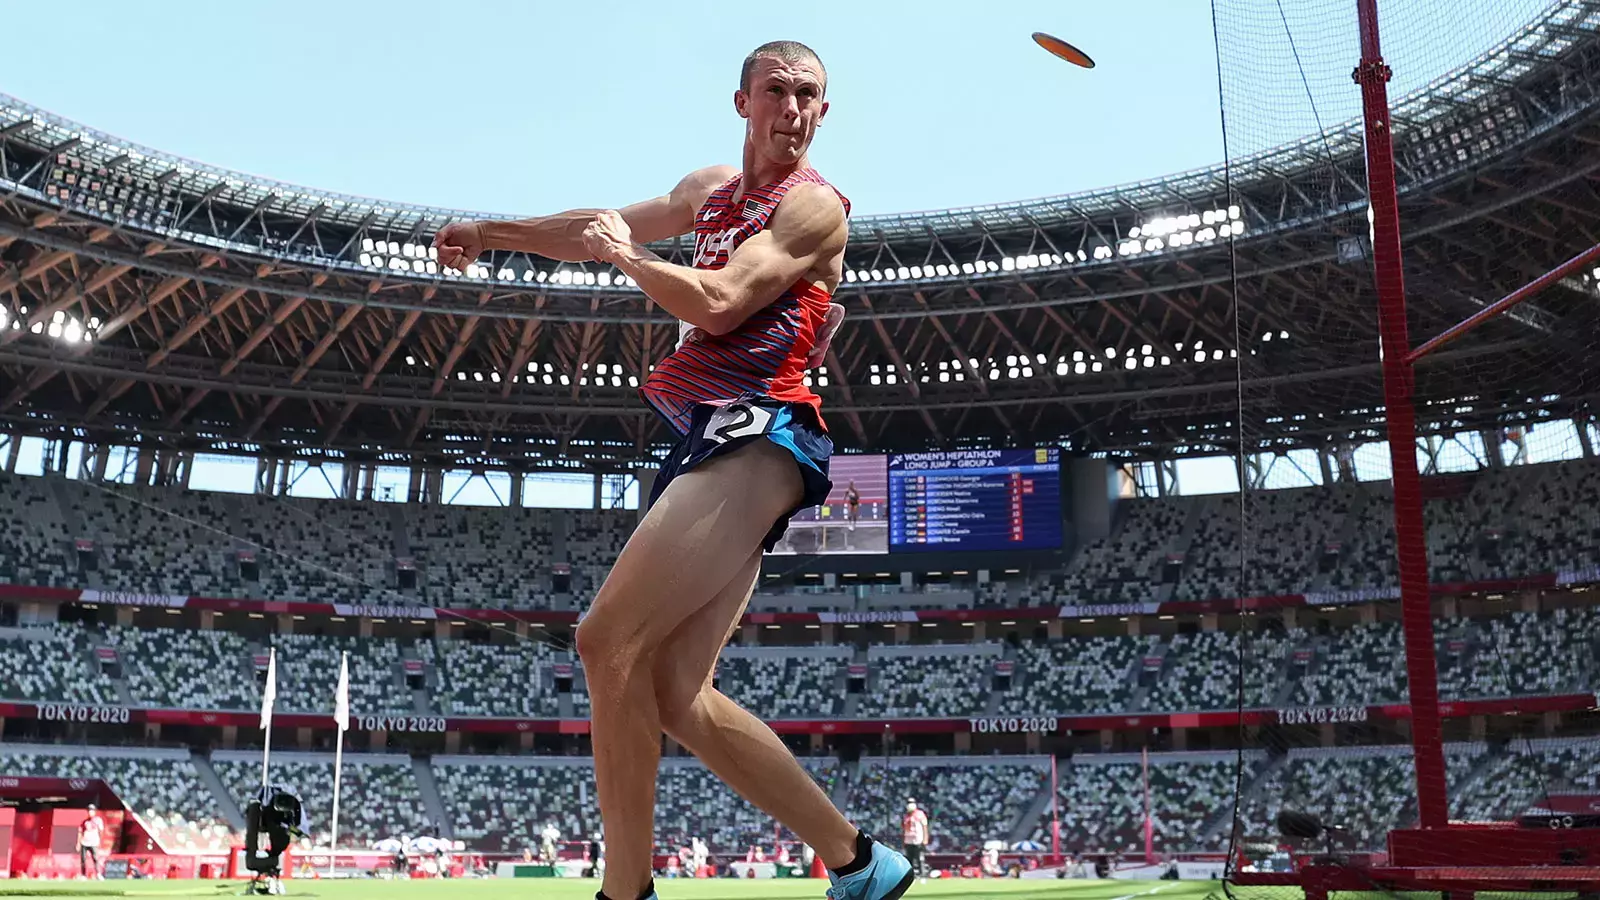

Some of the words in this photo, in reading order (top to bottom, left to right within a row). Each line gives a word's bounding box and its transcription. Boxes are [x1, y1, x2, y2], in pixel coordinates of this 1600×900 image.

[692, 227, 735, 268] USA
[713, 404, 755, 442] 2
[904, 452, 946, 462] WOMEN'S
[946, 450, 1001, 461] HEPTATHLON
[904, 461, 928, 470] LONG
[929, 460, 951, 469] JUMP
[957, 458, 985, 468] GROUP
[987, 459, 995, 467] A
[35, 703, 88, 721] TOKYO
[90, 706, 130, 723] 2020
[1277, 707, 1327, 725] TOKYO
[1329, 705, 1368, 722] 2020
[355, 715, 406, 732] TOKYO
[408, 716, 447, 732] 2020
[969, 718, 1019, 733] TOKYO
[1020, 716, 1058, 732] 2020
